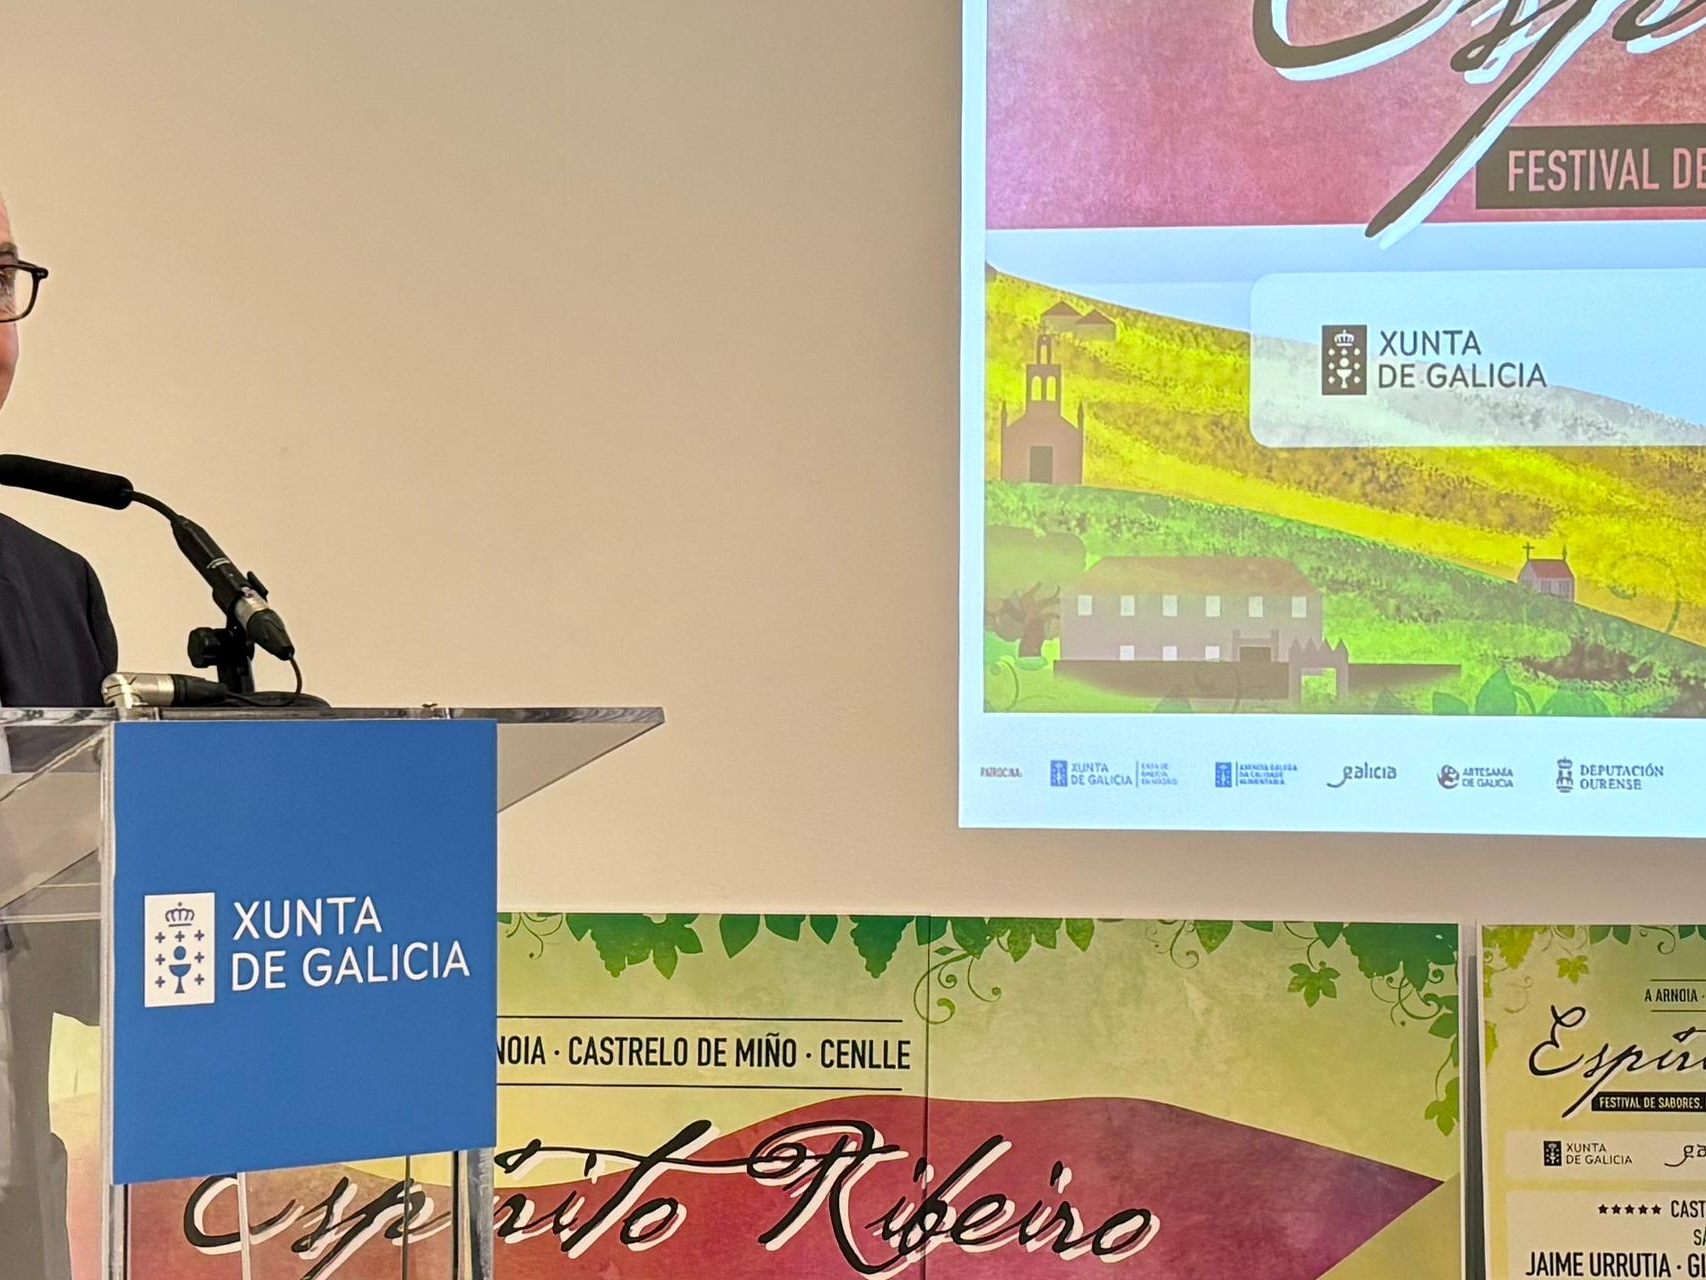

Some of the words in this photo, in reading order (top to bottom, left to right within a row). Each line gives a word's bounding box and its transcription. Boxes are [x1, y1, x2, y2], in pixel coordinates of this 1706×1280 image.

[1508, 147, 1659, 192] FESTIVAL
[1379, 329, 1481, 356] XUNTA
[1378, 362, 1417, 389] DE
[1425, 361, 1547, 389] GALICIA
[1071, 763, 1109, 773] XUNTA
[1327, 762, 1397, 788] galicia
[1580, 763, 1664, 777] DEPUTACIÓN
[1071, 775, 1085, 785] DE
[1088, 774, 1132, 786] GALICIA
[1580, 779, 1642, 790] OURENSE
[232, 896, 382, 941] XUNTA
[231, 950, 287, 992] DE
[302, 940, 470, 987] GALICIA
[1644, 988, 1652, 1003] A
[1655, 988, 1698, 1003] ARNOIA
[496, 1036, 546, 1065] NOIA
[568, 1036, 688, 1067] CASTRELO
[697, 1037, 727, 1067] DE
[735, 1032, 795, 1068] MIÑO
[820, 1039, 911, 1070] CENLLE
[1599, 1096, 1641, 1109] FESTIVAL
[1644, 1097, 1656, 1108] DE
[1566, 1143, 1607, 1153] XUNTA
[1566, 1154, 1582, 1164] DE
[1585, 1153, 1633, 1165] GALICIA
[1525, 1251, 1584, 1277] JAIME
[1590, 1253, 1671, 1278] URRUTIA
